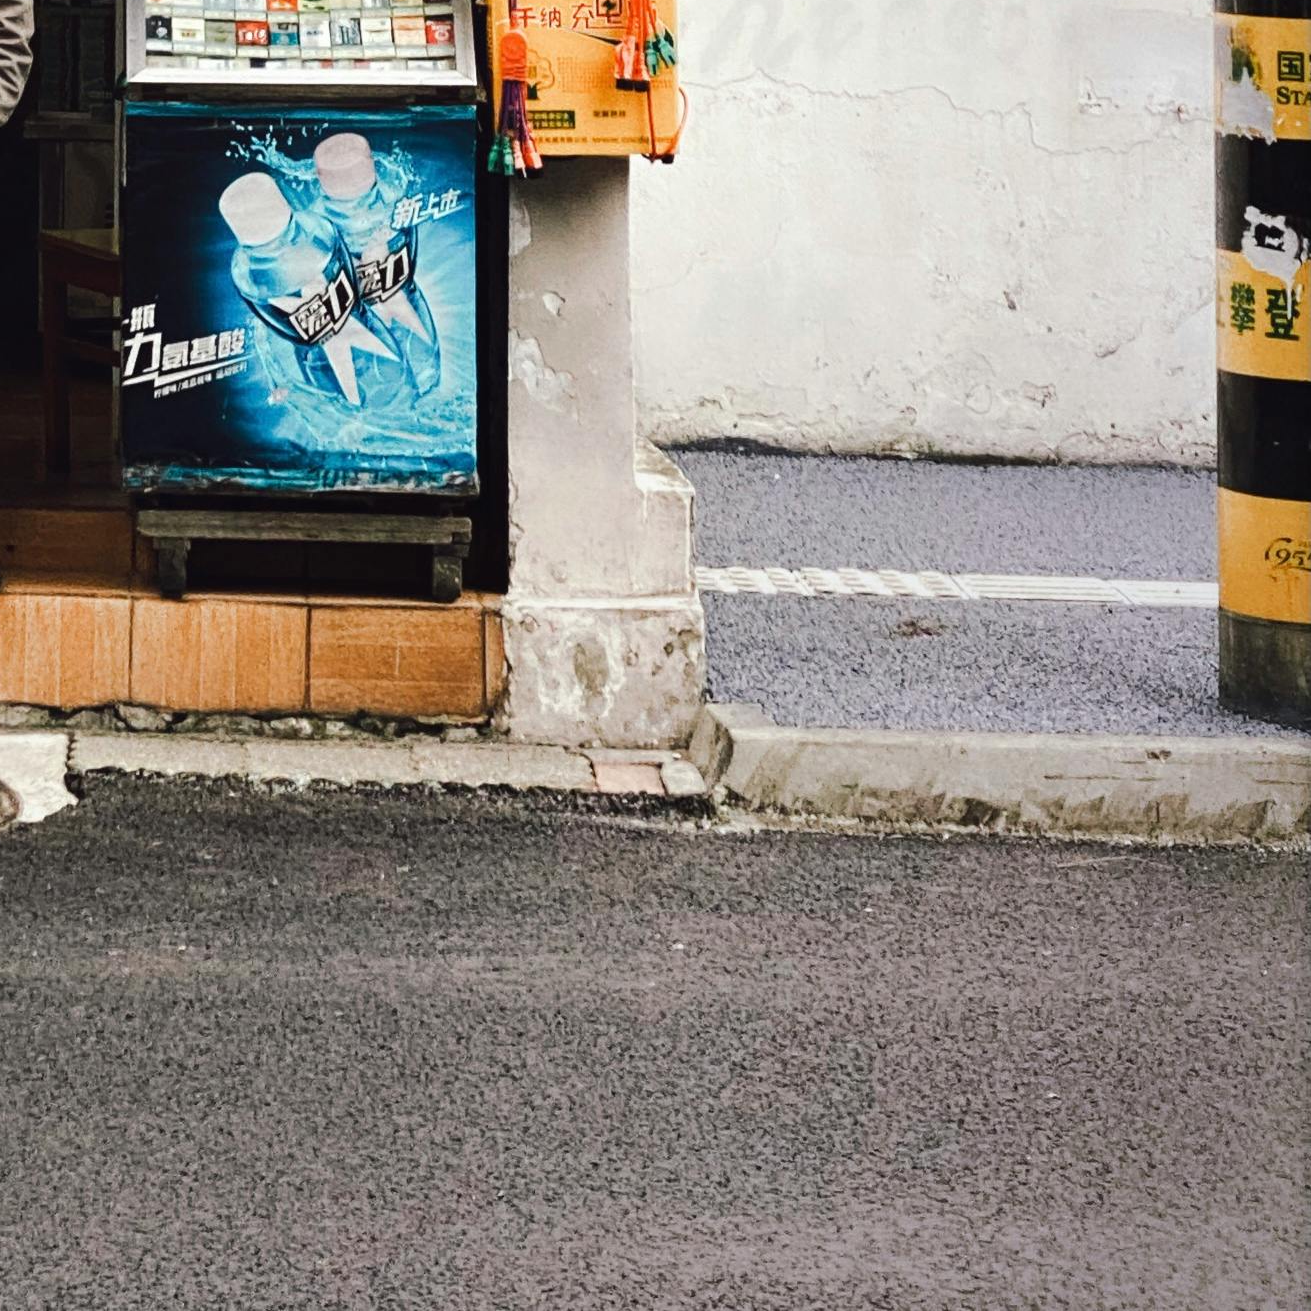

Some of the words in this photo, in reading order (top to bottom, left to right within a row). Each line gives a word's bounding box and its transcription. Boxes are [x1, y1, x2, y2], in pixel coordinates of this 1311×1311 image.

[391, 188, 462, 230] 新上市
[1217, 281, 1301, 342] 攀登
[123, 328, 246, 377] 力氨基酸
[1274, 547, 1311, 567] 95
